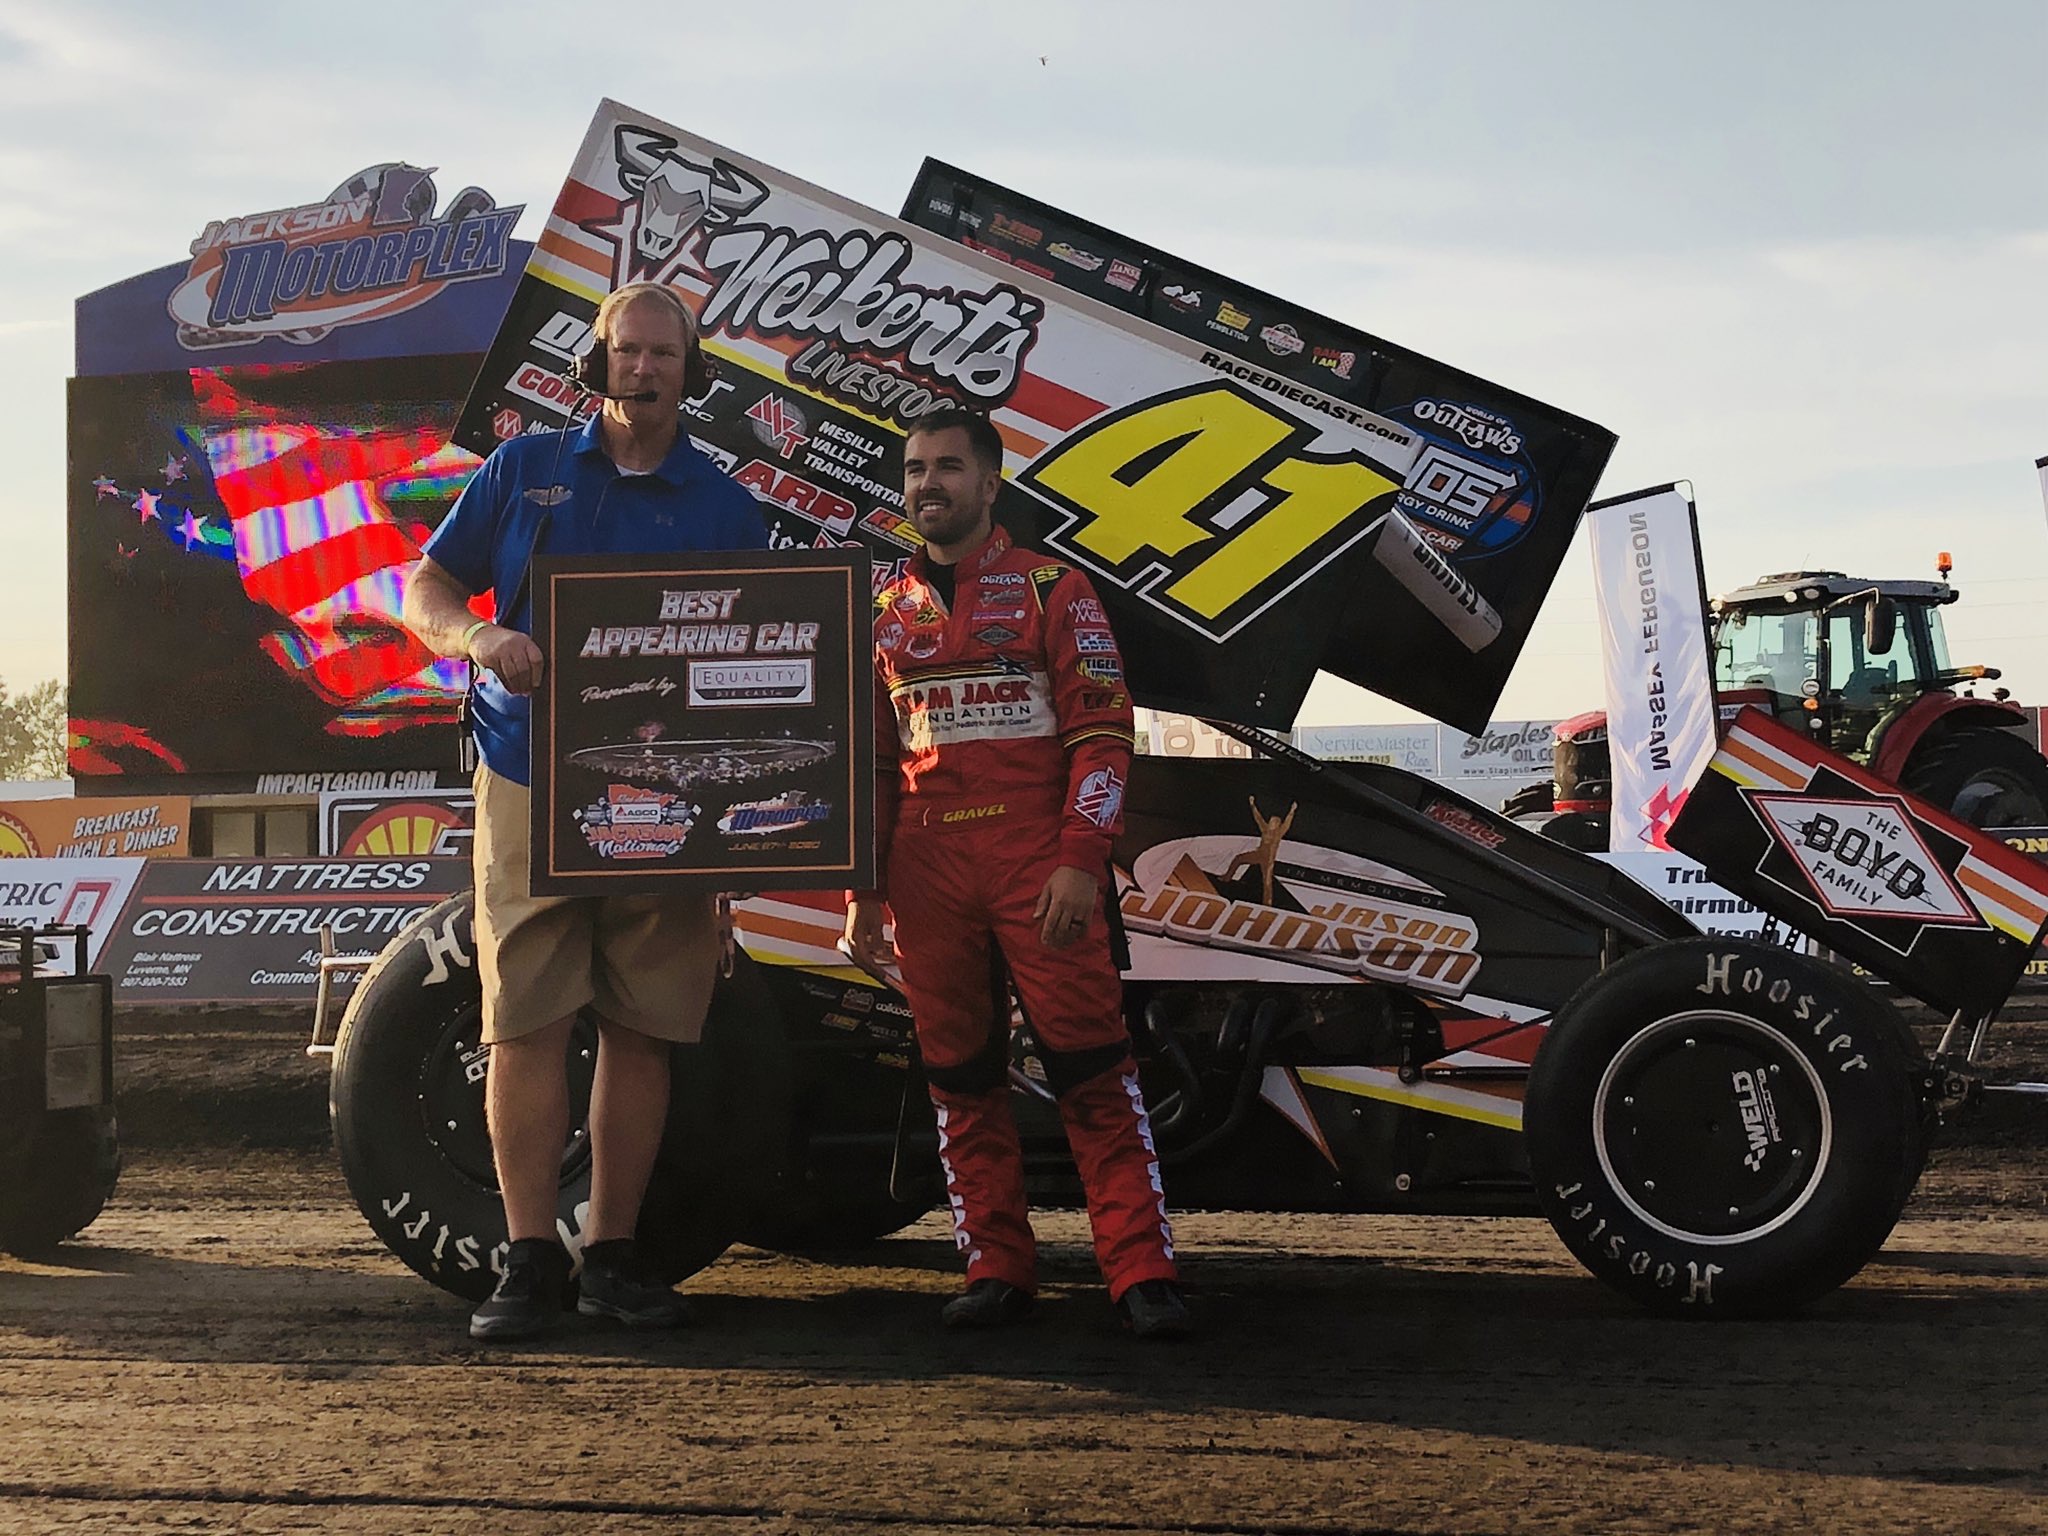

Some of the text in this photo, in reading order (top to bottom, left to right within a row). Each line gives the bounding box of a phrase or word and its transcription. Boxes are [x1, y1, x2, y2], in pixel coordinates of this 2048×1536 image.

[193, 200, 372, 250] JACKSON
[212, 206, 520, 321] MOTORPLEX
[702, 228, 1040, 398] Weikert's
[1201, 351, 1411, 448] RACEDIECAST.com
[818, 420, 885, 459] MESILLA
[1413, 400, 1522, 455] OUTLAWS
[810, 436, 868, 469] VALLEY
[732, 460, 856, 522] ARP
[1033, 389, 1402, 620] 41
[1425, 506, 1475, 530] DRINK
[659, 588, 741, 620] BEST
[580, 621, 820, 658] APPEARING CAR
[580, 676, 678, 703] Presented by
[702, 668, 797, 686] EQUALITY
[960, 681, 1032, 705] JACK
[1461, 722, 1551, 759] Staples
[1511, 747, 1535, 762] OIL
[256, 770, 437, 793] IMPACT4800.COM
[73, 806, 161, 838] BREAKFAST,
[942, 803, 1007, 822] GRAVEL
[1866, 811, 1903, 841] THE
[105, 838, 117, 856] &
[123, 825, 179, 852] DINNER
[590, 840, 682, 858] Nationals
[1803, 812, 1926, 901] BOYD
[202, 862, 431, 890] NATTRESS
[1812, 860, 1883, 907] FAMILY
[1120, 891, 1479, 988] JOHNSON
[1311, 902, 1472, 948] JASON
[133, 951, 202, 963] Blair Nattress
[172, 964, 193, 974] MN
[1696, 952, 1868, 1074] Hoosier
[1732, 1070, 1769, 1152] WELD
[1556, 1181, 1724, 1303] Hoosier
